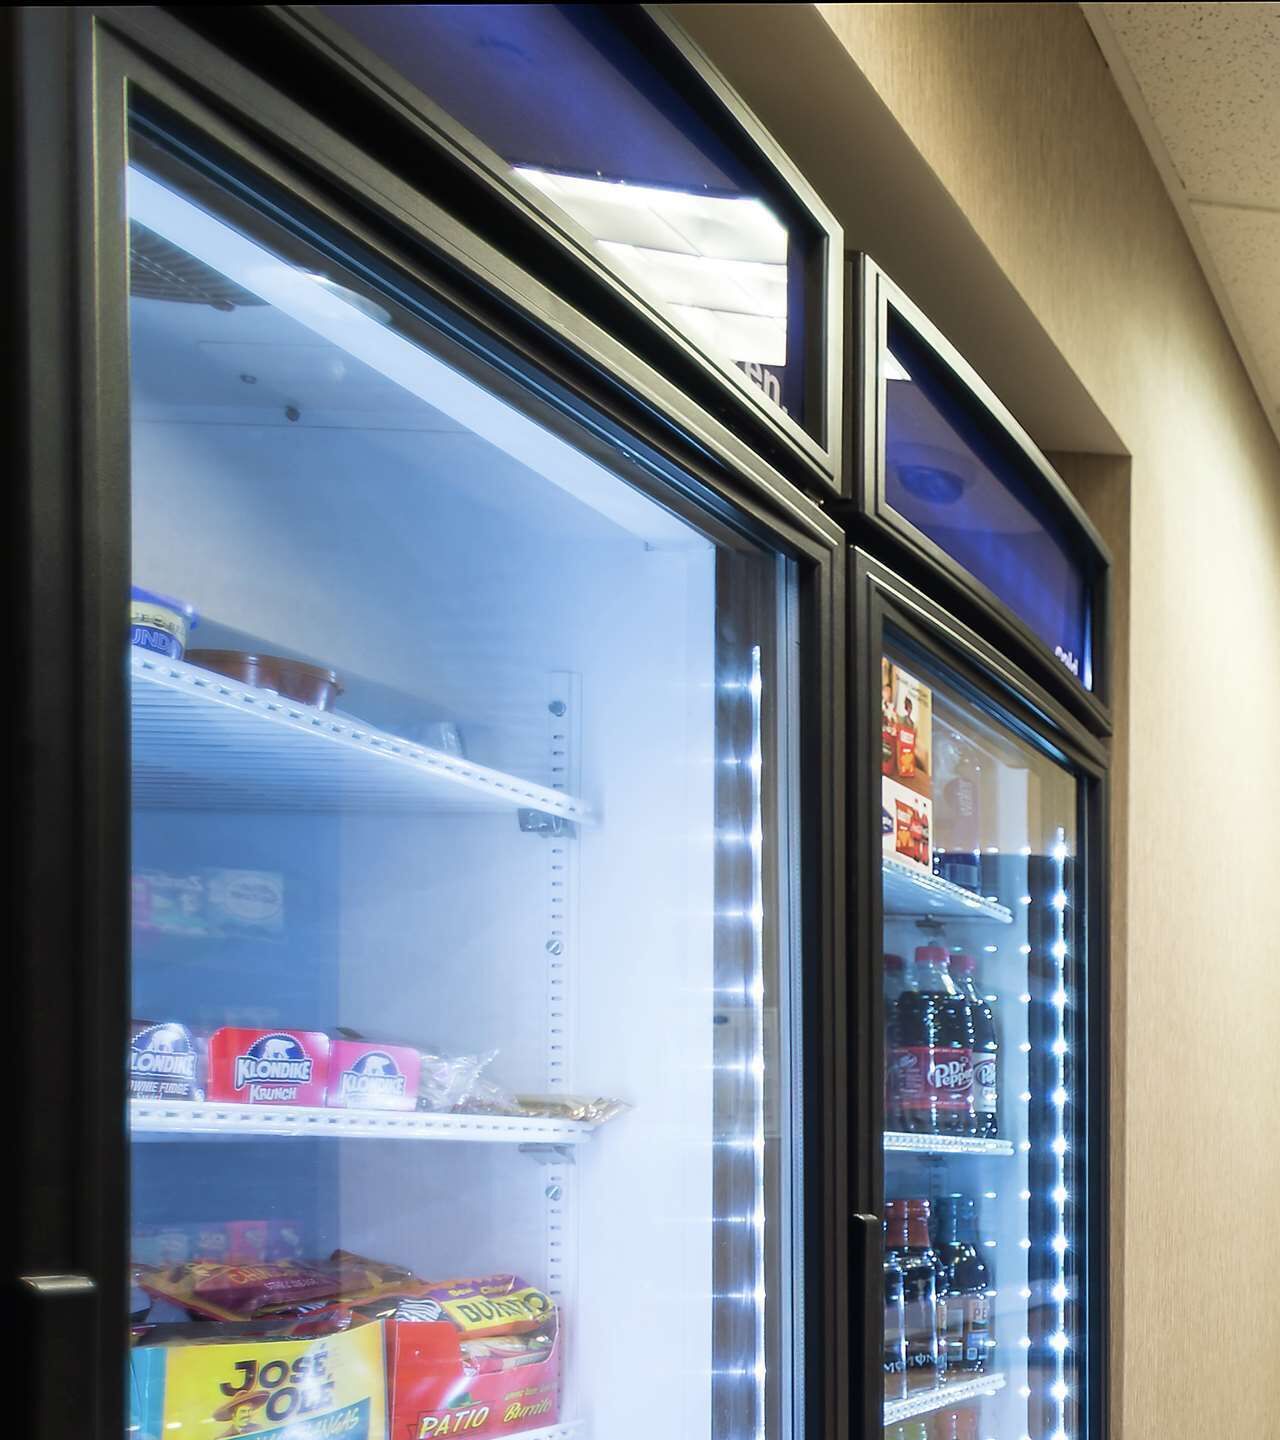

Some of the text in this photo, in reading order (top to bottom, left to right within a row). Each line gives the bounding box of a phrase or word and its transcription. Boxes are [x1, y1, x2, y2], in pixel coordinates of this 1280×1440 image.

[131, 1053, 195, 1077] LONDIKE
[237, 1059, 311, 1087] KLONDIKE
[950, 1061, 966, 1074] Dr
[251, 1085, 296, 1100] KRUNCH
[418, 1407, 489, 1439] PATIO
